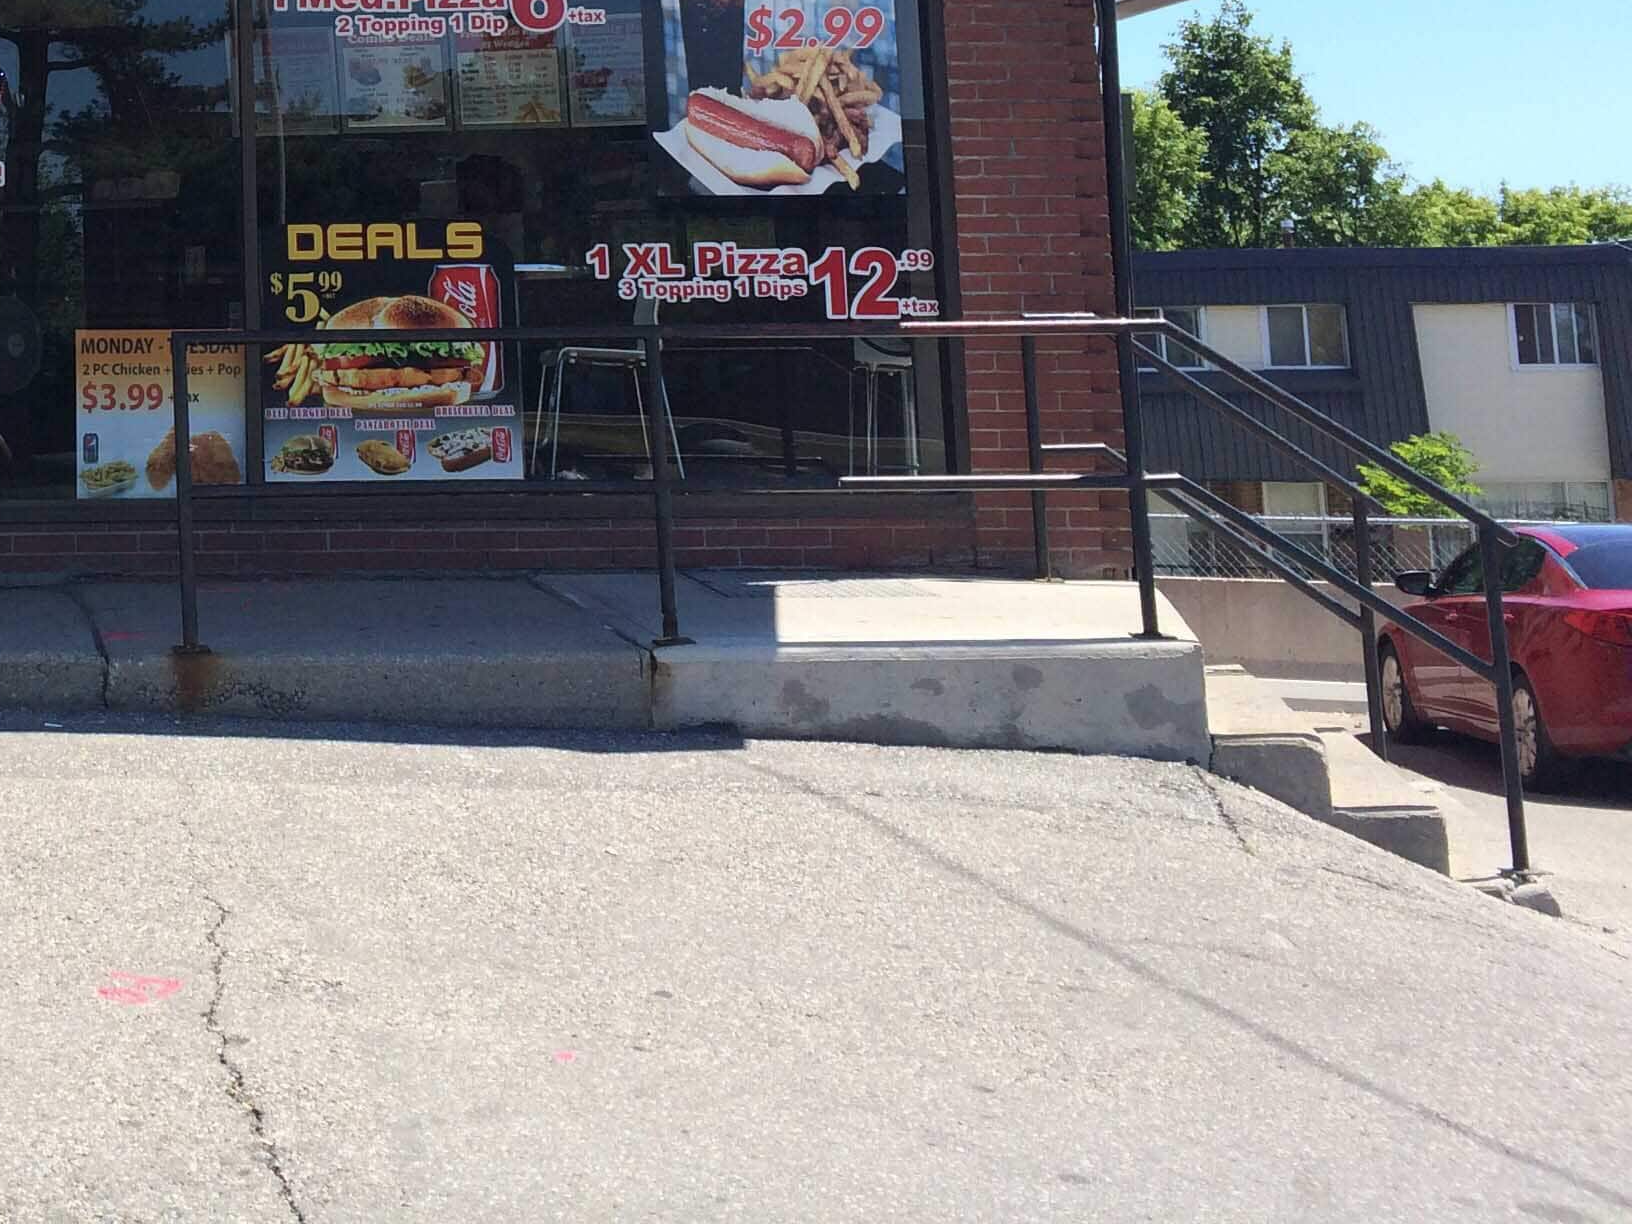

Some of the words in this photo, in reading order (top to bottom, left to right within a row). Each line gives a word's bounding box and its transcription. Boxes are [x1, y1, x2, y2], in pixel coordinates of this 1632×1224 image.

[336, 14, 352, 35] 2
[355, 14, 446, 39] Topping
[448, 14, 462, 34] 1
[467, 12, 509, 38] Dip
[745, 4, 886, 57] $2.99
[287, 222, 484, 261] DEALS
[586, 243, 610, 279] 1
[622, 242, 685, 279] XL
[693, 240, 808, 278] Pizza
[619, 279, 635, 299] 3
[638, 279, 733, 304] Topping
[735, 279, 750, 298] 1
[756, 278, 808, 300] Dips
[80, 337, 154, 355] MONDAY
[82, 364, 90, 376] 2
[93, 364, 109, 376] PC
[112, 362, 160, 376] Chicken
[217, 364, 241, 379] Pop
[82, 381, 164, 415] $3.99
